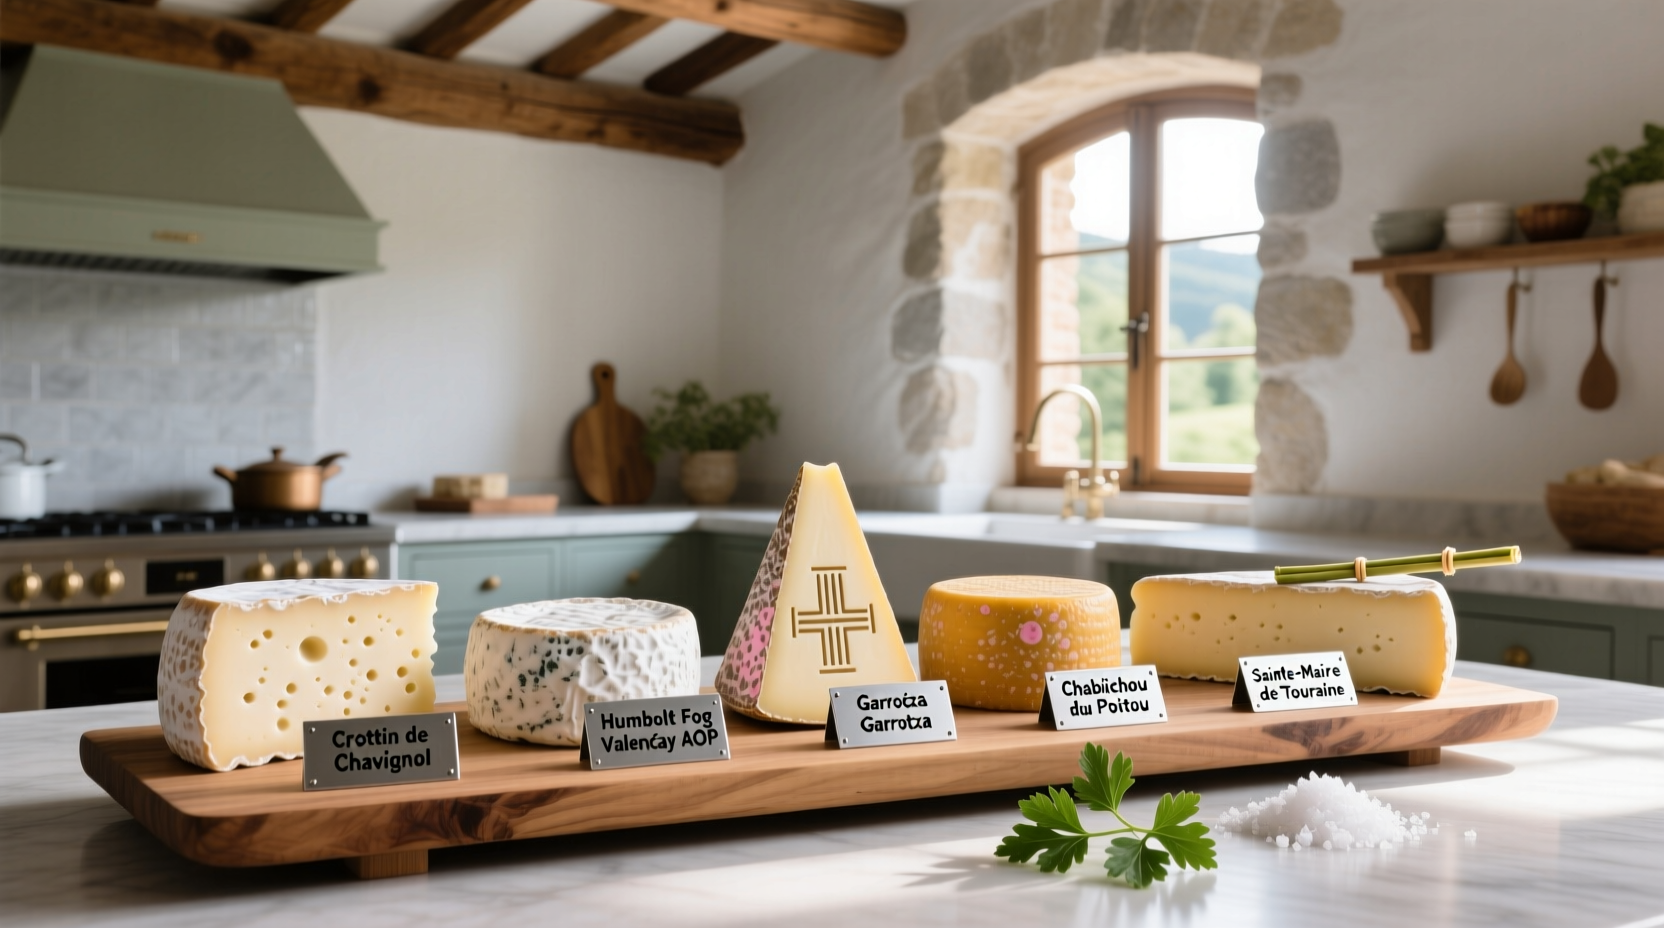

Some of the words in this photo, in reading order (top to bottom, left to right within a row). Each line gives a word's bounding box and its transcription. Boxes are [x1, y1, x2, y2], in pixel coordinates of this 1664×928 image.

[1251, 663, 1341, 682] Sainte-Maire
[1260, 685, 1278, 700] de
[1279, 682, 1345, 699] Touraine
[1097, 698, 1149, 714] Poitou
[601, 709, 676, 730] Humbolt
[681, 708, 713, 728] Fog
[332, 727, 399, 748] Crottin
[405, 725, 429, 743] de
[681, 728, 719, 747] AOP
[334, 748, 431, 773] Chavignol
